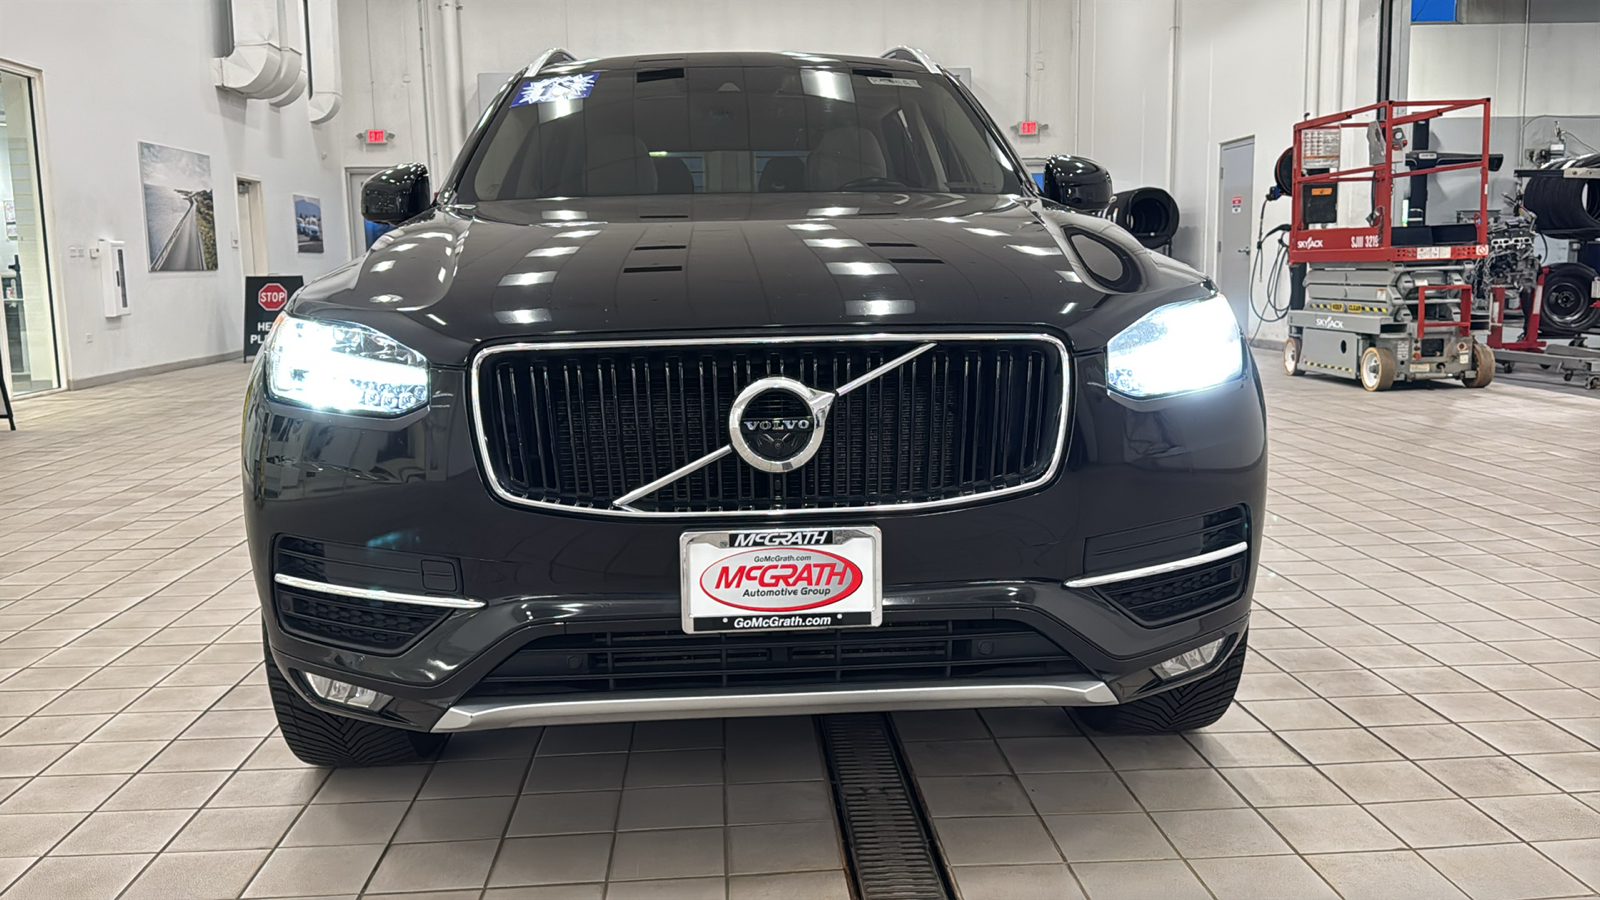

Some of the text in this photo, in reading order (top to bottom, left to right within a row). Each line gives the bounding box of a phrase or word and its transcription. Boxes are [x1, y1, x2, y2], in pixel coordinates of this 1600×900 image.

[260, 292, 285, 303] STOP
[257, 322, 273, 331] HE
[744, 419, 809, 430] VOLVO
[753, 555, 812, 563] GoMcGrath.com
[742, 587, 831, 598] Automotive Group
[734, 615, 831, 629] GoMcGrath.com
